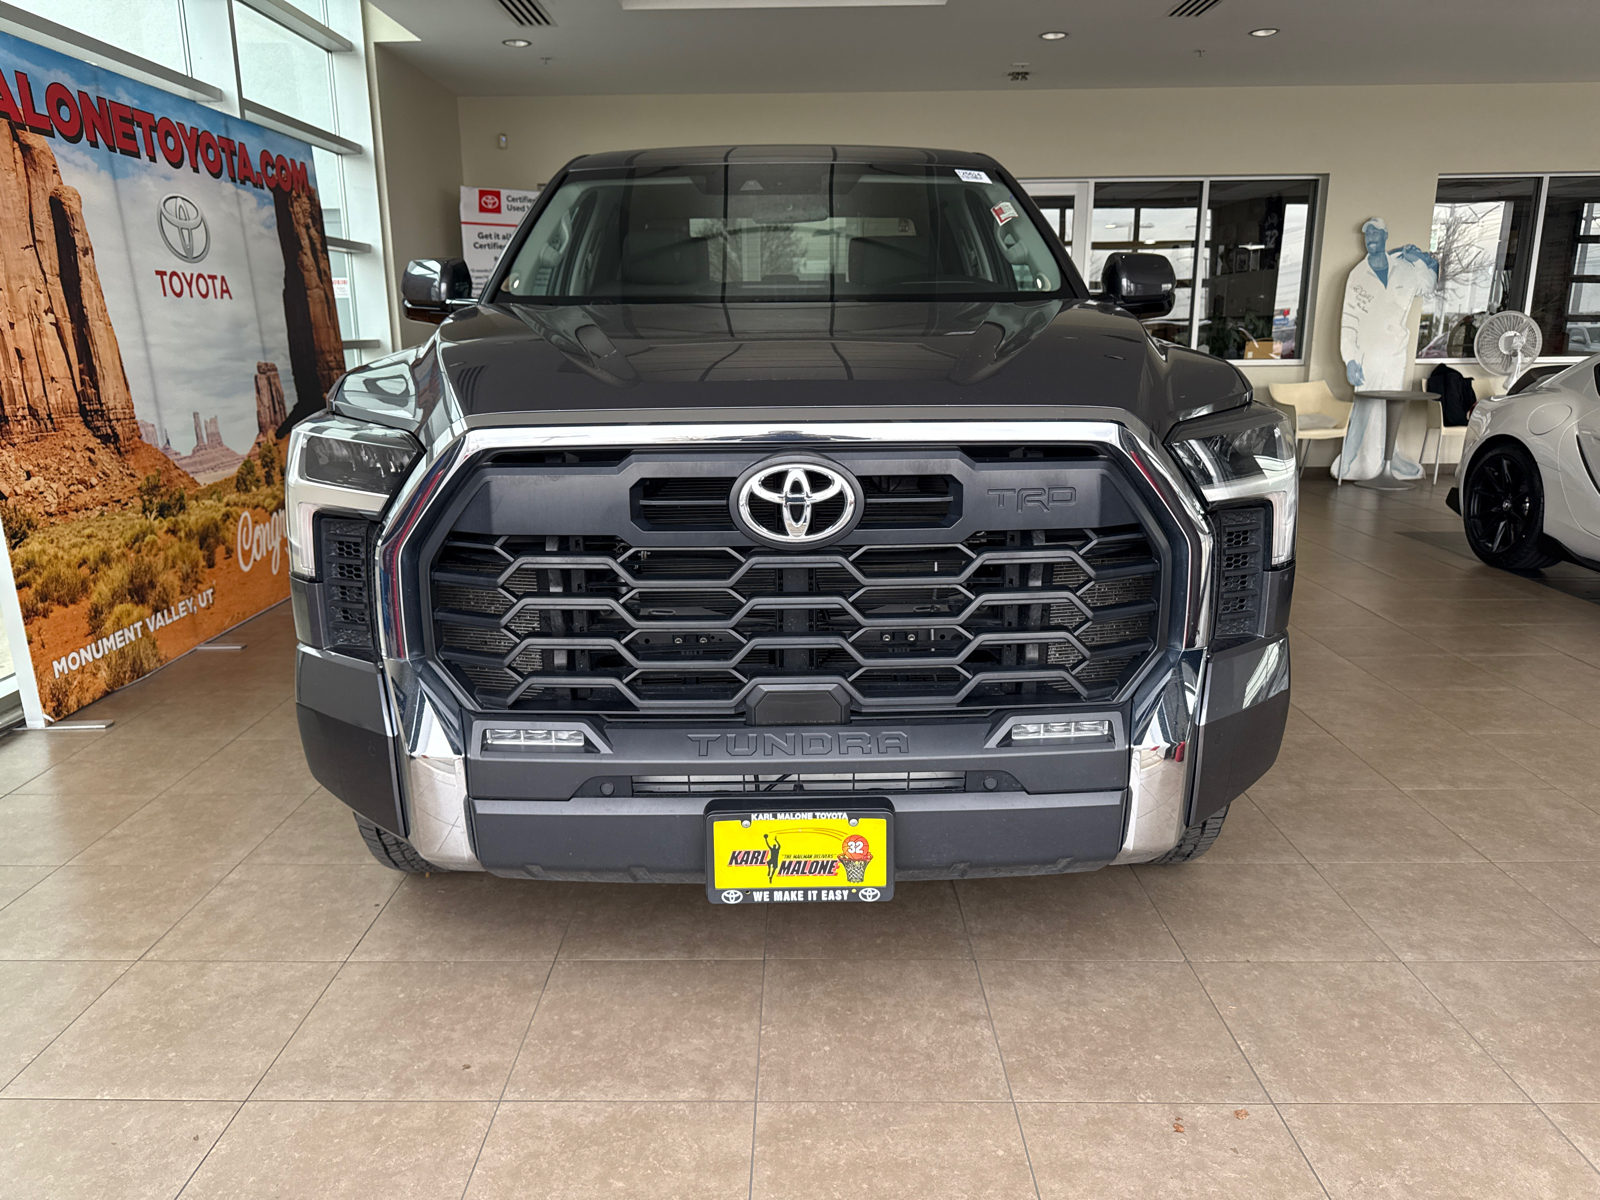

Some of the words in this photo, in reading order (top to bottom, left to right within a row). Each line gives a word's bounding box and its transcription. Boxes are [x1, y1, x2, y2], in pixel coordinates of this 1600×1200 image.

[506, 204, 526, 212] Used
[477, 231, 492, 240] Get
[493, 232, 500, 240] it
[155, 270, 233, 300] TOYOTA
[987, 486, 1077, 513] TRD
[52, 620, 143, 679] MONUMENT
[145, 596, 198, 633] VALLEY,
[198, 587, 214, 608] UT
[687, 731, 910, 757] TUNDRA
[751, 813, 776, 821] KARL
[777, 812, 813, 821] MALONE
[815, 812, 849, 820] TOYOTA
[847, 841, 864, 854] 32
[728, 850, 769, 867] KARL
[777, 860, 839, 876] MALONE
[753, 891, 772, 902] WE
[773, 890, 804, 901] MAKE
[808, 890, 821, 901] IT
[823, 889, 849, 901] EASY
